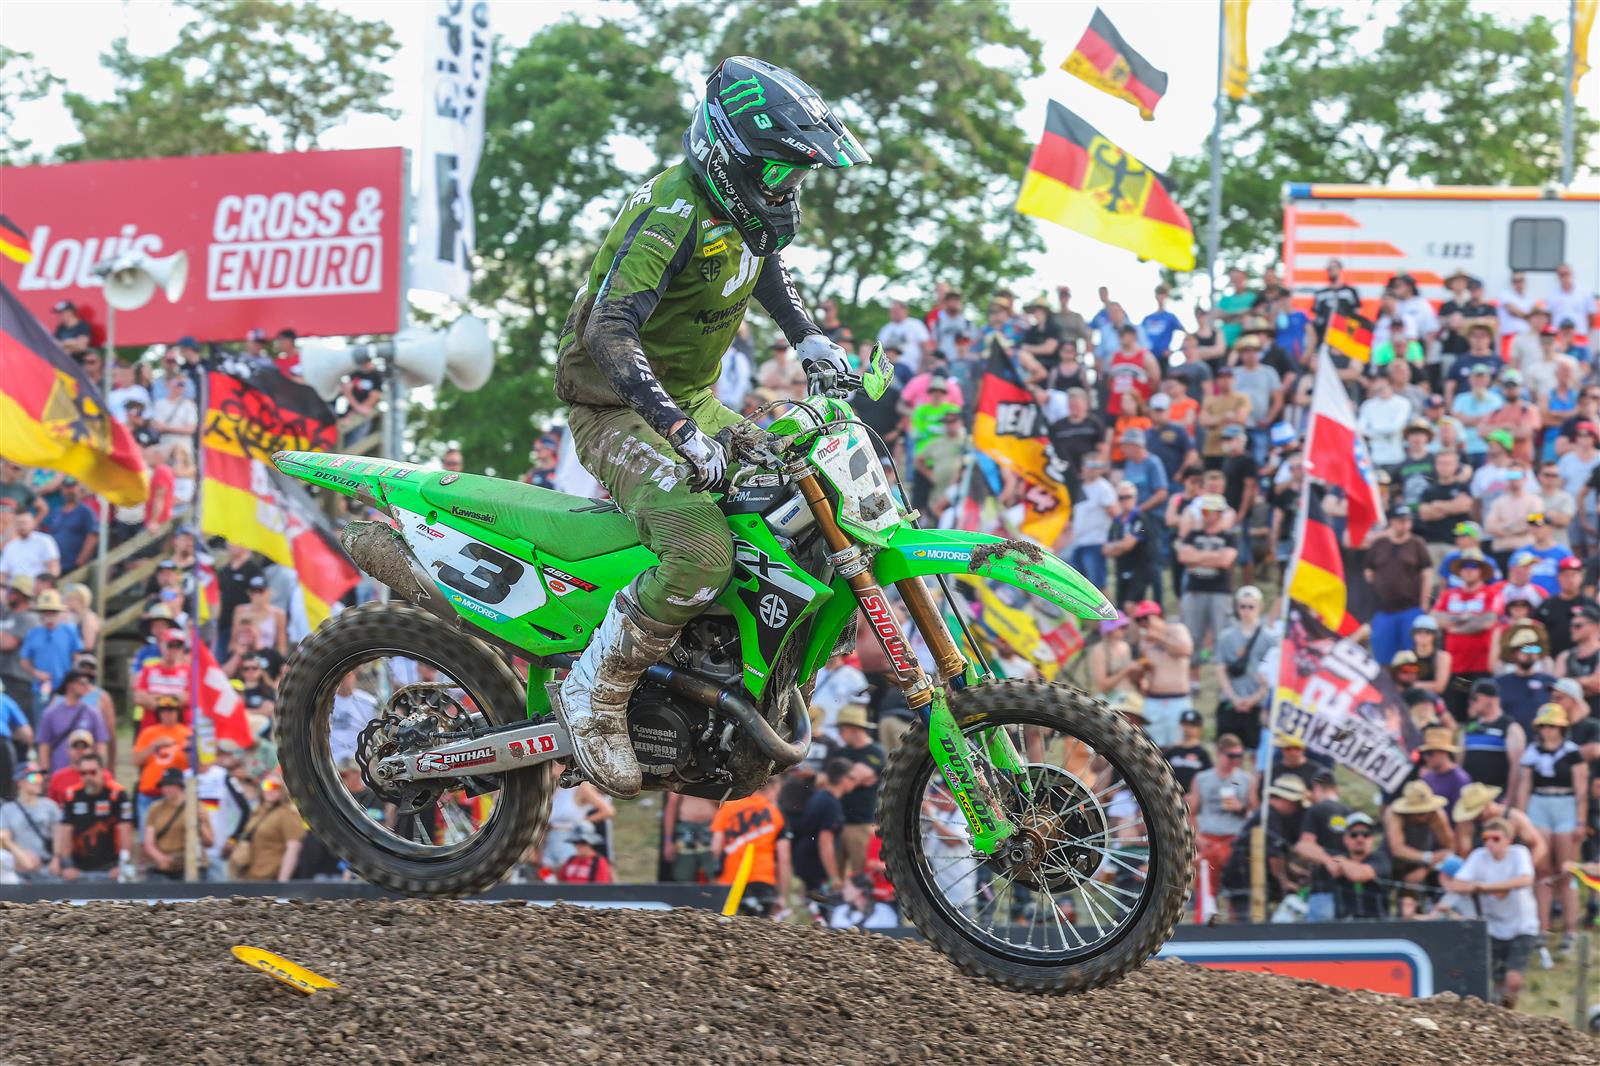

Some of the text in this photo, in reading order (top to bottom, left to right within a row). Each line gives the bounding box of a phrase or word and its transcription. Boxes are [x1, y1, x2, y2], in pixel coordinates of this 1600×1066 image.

[753, 113, 773, 131] 3
[212, 189, 346, 243] CROSS
[347, 186, 385, 237] &
[215, 243, 375, 292] ENDURO
[816, 438, 840, 460] MXGP
[451, 505, 495, 525] Kawasaki
[416, 523, 445, 539] MXGP
[927, 548, 972, 562] MOTOREX
[434, 542, 525, 605] 3
[543, 567, 593, 592] 450SR
[461, 597, 500, 621] MOTOREX
[632, 723, 678, 739] Kawasaki
[416, 746, 495, 773] RENTHAL
[938, 737, 997, 832] DUNLOP
[957, 792, 982, 833] ACERBIS
